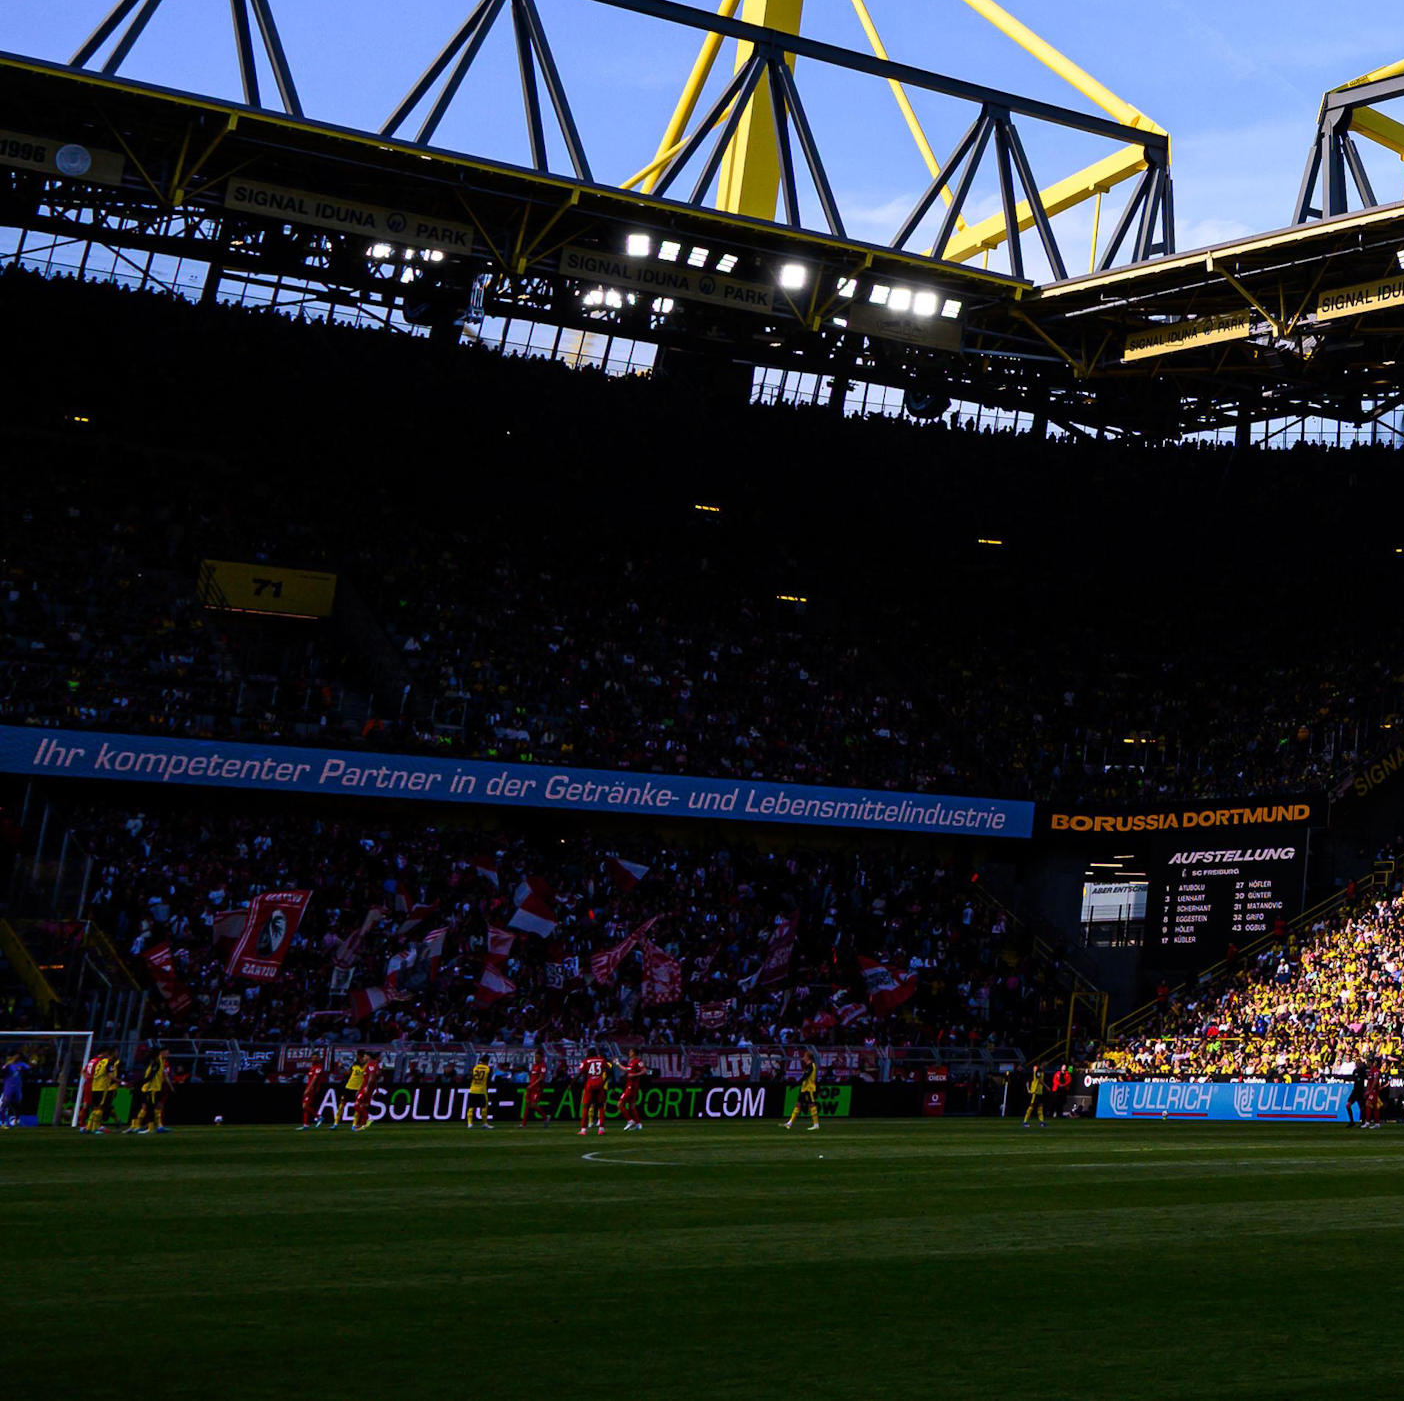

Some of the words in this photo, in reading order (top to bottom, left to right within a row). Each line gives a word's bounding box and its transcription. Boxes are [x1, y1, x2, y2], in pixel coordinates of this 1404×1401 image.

[235, 187, 308, 214] SIGNAL
[315, 203, 376, 228] IDUNA
[416, 224, 466, 246] PARK
[567, 254, 633, 281] SIGNAL
[637, 269, 690, 291] IDUNA
[724, 285, 769, 306] PARK
[1321, 292, 1374, 313] SIGNAL
[1129, 333, 1165, 351] SIGNAL
[1165, 326, 1198, 343] IDUNA
[1217, 316, 1246, 333] PARK
[33, 738, 85, 767] Ihr
[95, 741, 310, 782] kompetenter
[318, 758, 441, 793] Partner
[450, 768, 475, 794] in
[485, 770, 536, 798] der
[545, 775, 680, 808] Getränke-
[688, 788, 738, 812] und
[745, 789, 1006, 831] Lebensmittelindustrie
[1051, 812, 1178, 832] BORUSSIA
[1182, 804, 1311, 829] DORTMUND
[1168, 847, 1296, 865] AUFSTELLUNG
[1203, 868, 1240, 876] FREIBURG
[589, 1062, 602, 1075] 43
[319, 1086, 767, 1121] ASOLUT-TEASPORT.COM
[1132, 1086, 1210, 1110] ULLRICH
[1257, 1086, 1342, 1112] ULLRICH
